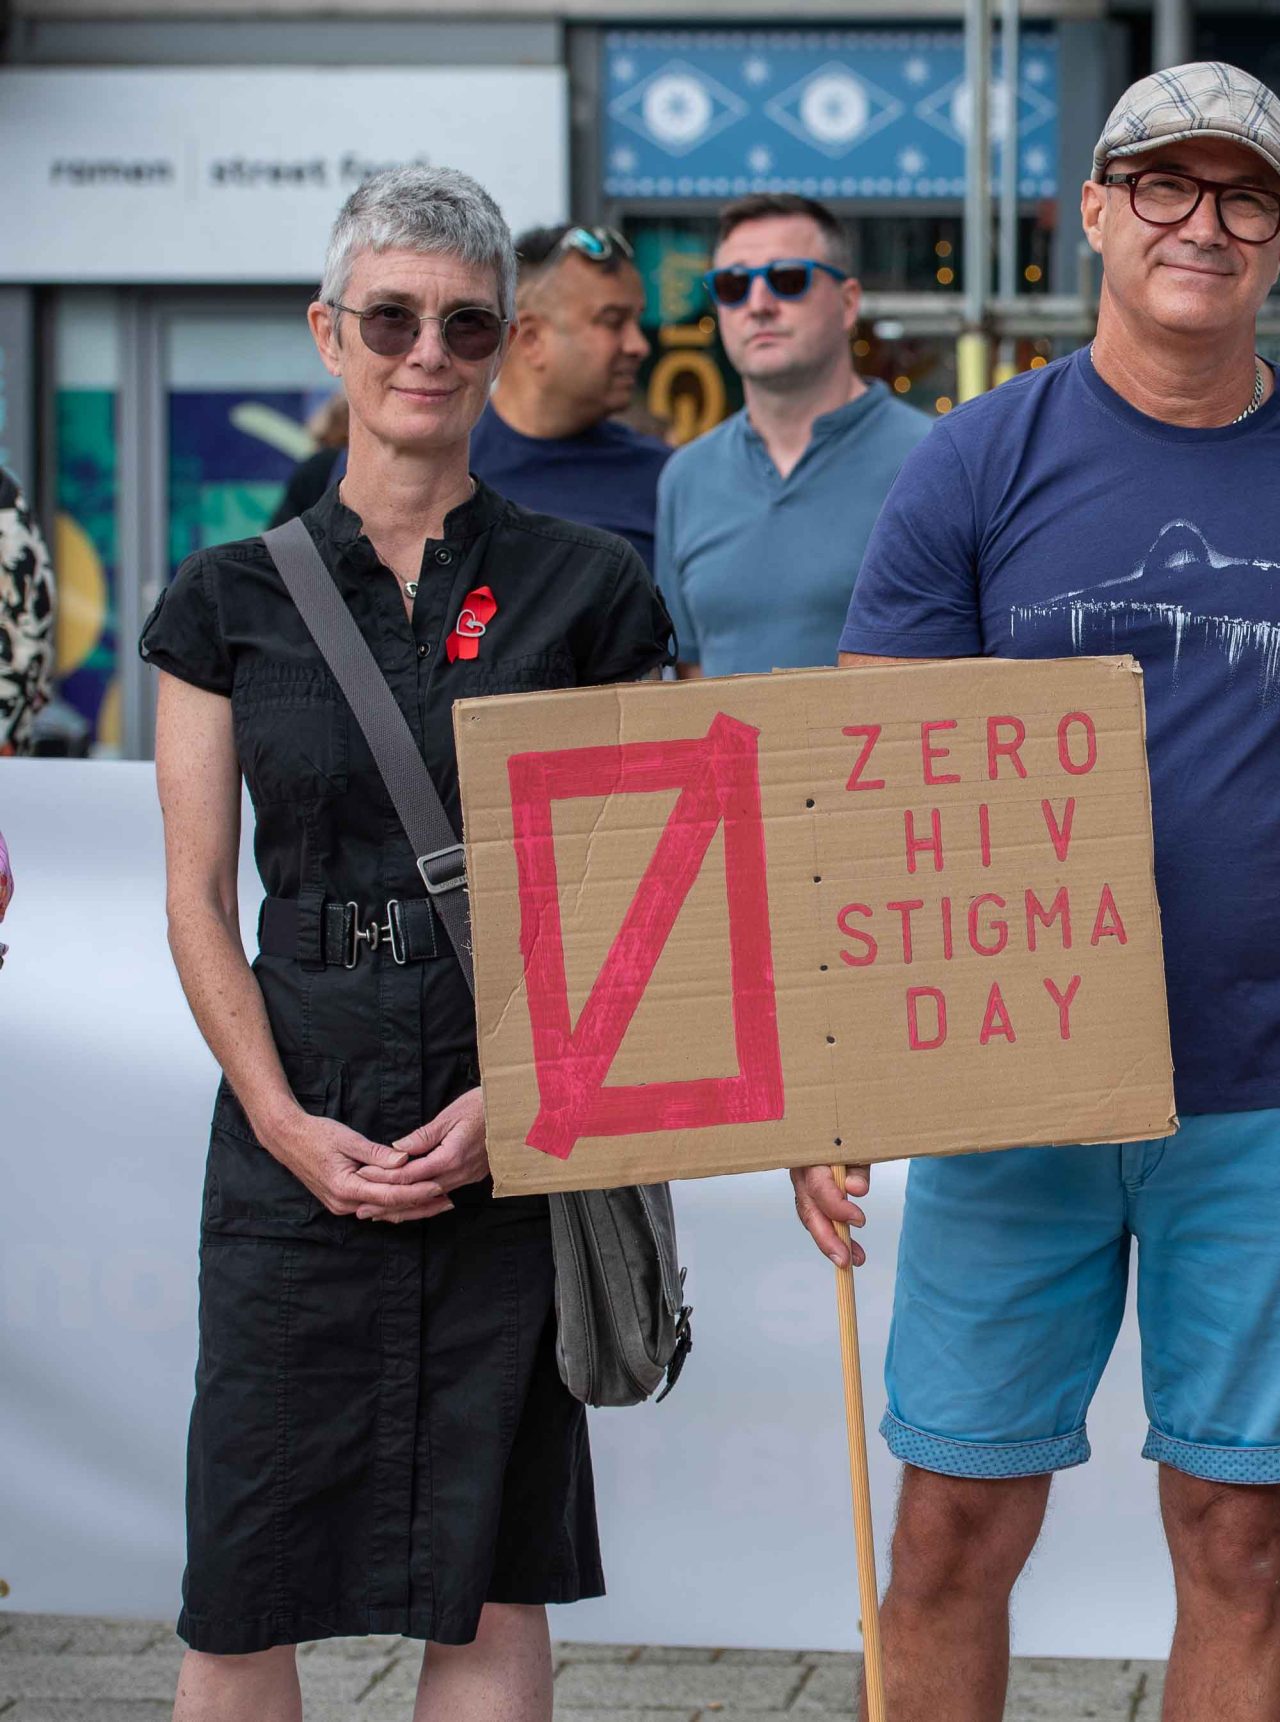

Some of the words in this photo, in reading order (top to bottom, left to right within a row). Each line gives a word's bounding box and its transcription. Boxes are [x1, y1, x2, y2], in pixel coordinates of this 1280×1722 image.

[841, 712, 1099, 792] ZERO
[904, 797, 1076, 874] HIV
[836, 882, 1128, 968] STIGMA
[907, 975, 1081, 1051] DAY
